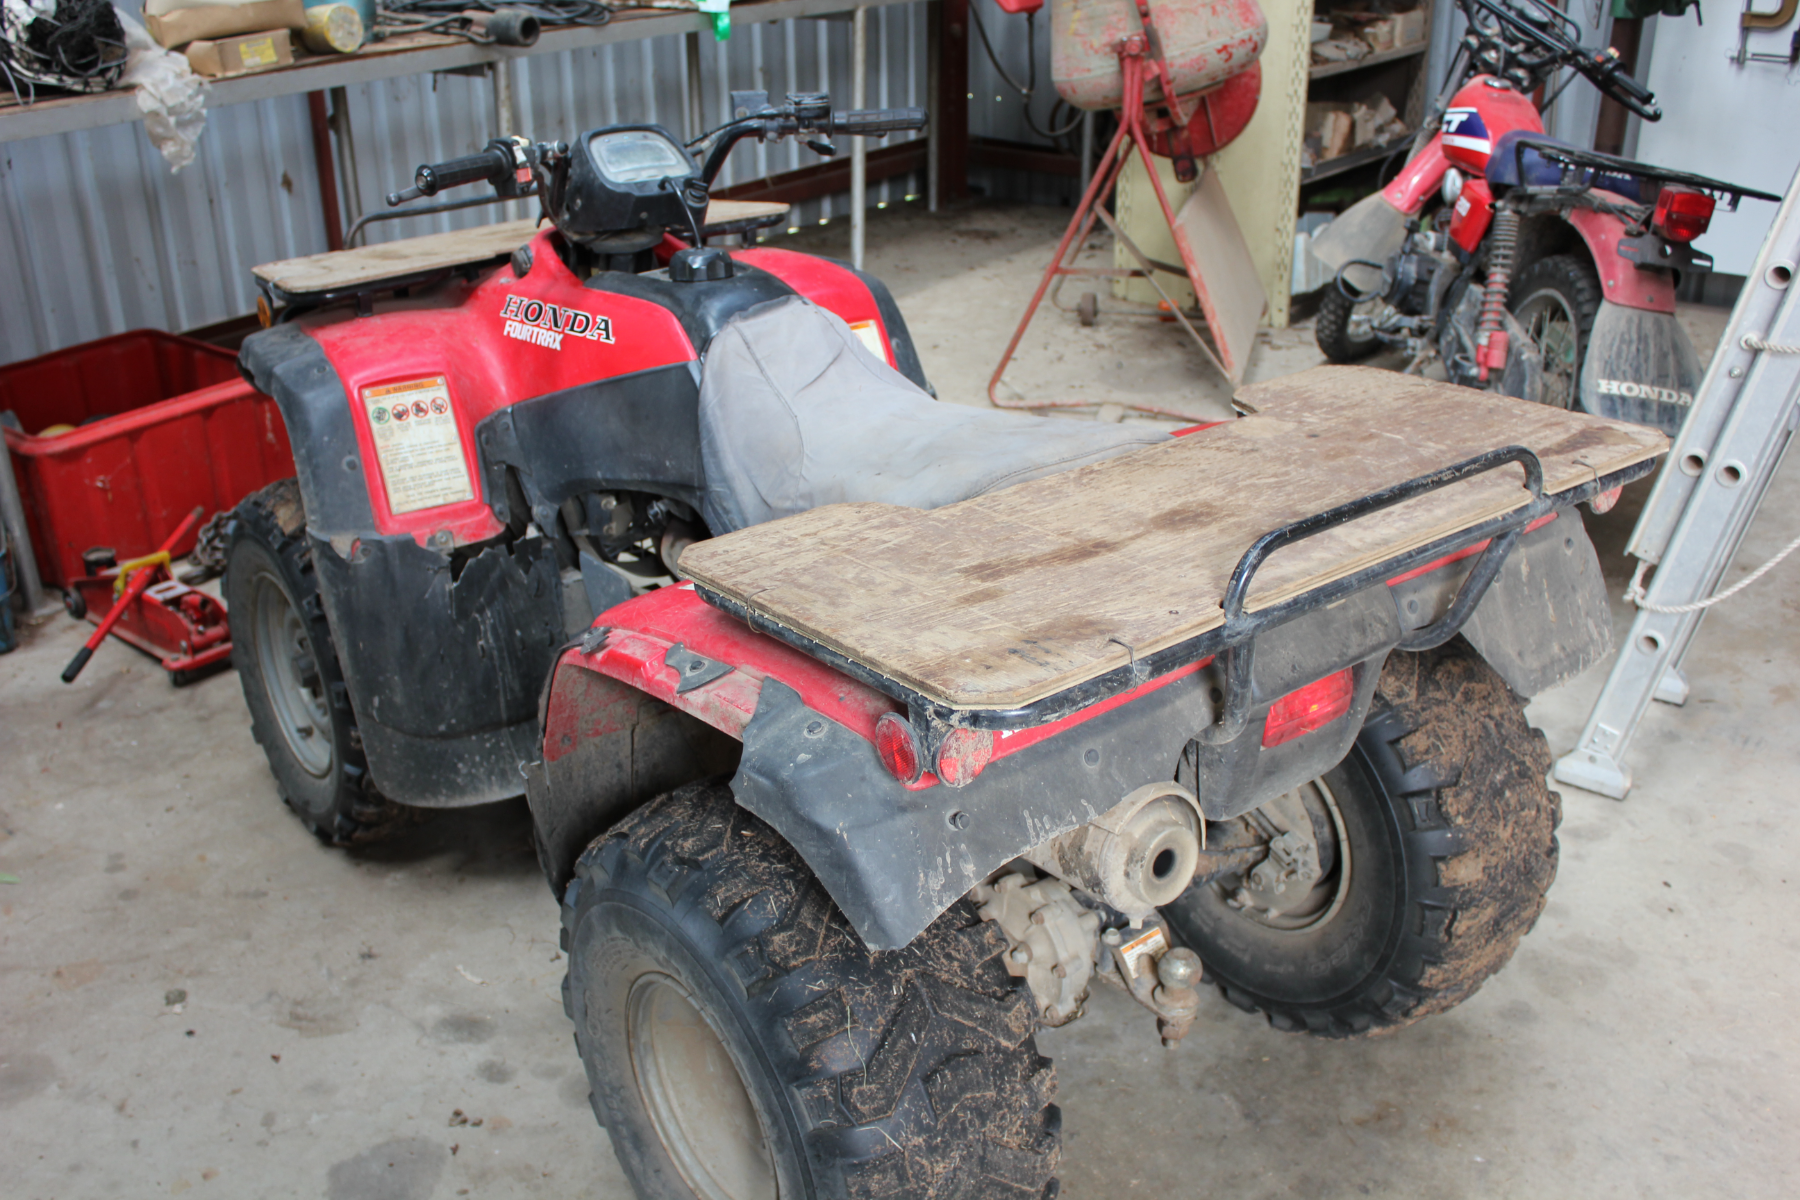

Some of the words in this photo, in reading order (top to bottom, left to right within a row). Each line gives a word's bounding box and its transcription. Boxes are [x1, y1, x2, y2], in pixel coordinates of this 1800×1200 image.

[500, 294, 616, 344] HONDA
[503, 320, 564, 351] FOURTRAX
[393, 382, 425, 392] WARNING
[1597, 379, 1693, 406] HONDA
